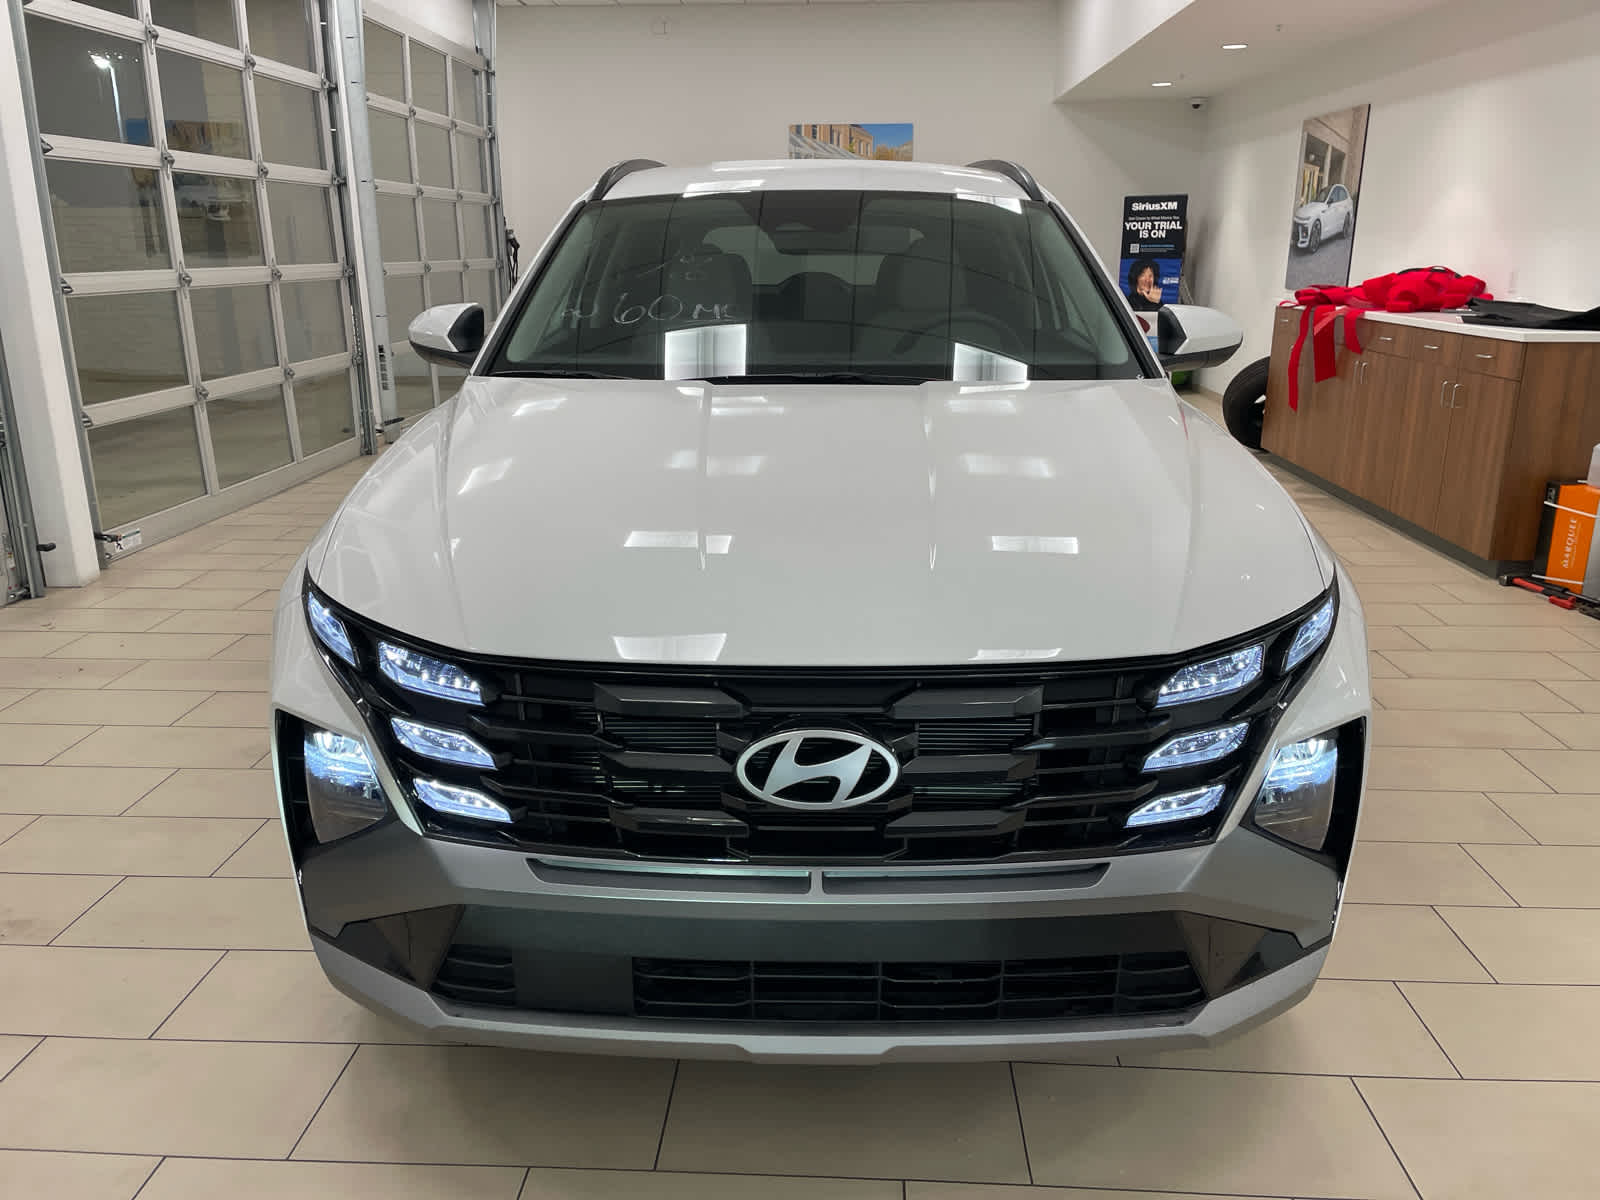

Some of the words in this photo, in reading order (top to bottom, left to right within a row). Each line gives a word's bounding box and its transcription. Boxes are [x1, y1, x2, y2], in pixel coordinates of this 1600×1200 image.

[1131, 201, 1178, 211] SiriusXM
[1124, 221, 1152, 231] YOUR
[1153, 220, 1183, 230] TRIAL
[1139, 229, 1149, 239] IS
[1150, 229, 1166, 238] ON
